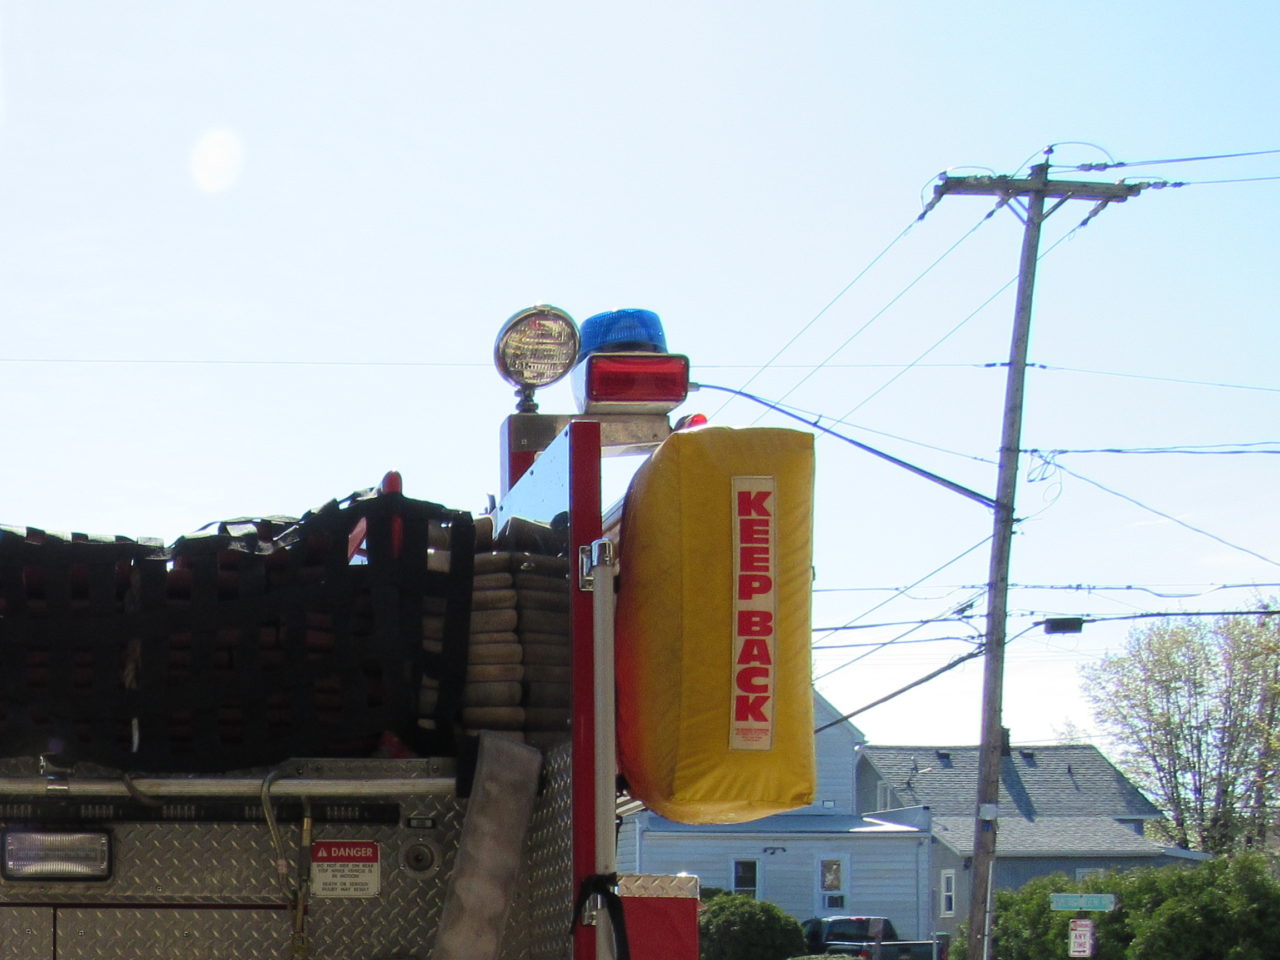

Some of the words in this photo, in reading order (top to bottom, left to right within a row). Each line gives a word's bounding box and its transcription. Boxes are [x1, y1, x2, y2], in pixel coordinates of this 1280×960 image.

[736, 490, 773, 601] KEEP
[734, 609, 774, 723] BACK
[331, 847, 374, 857] DANGER
